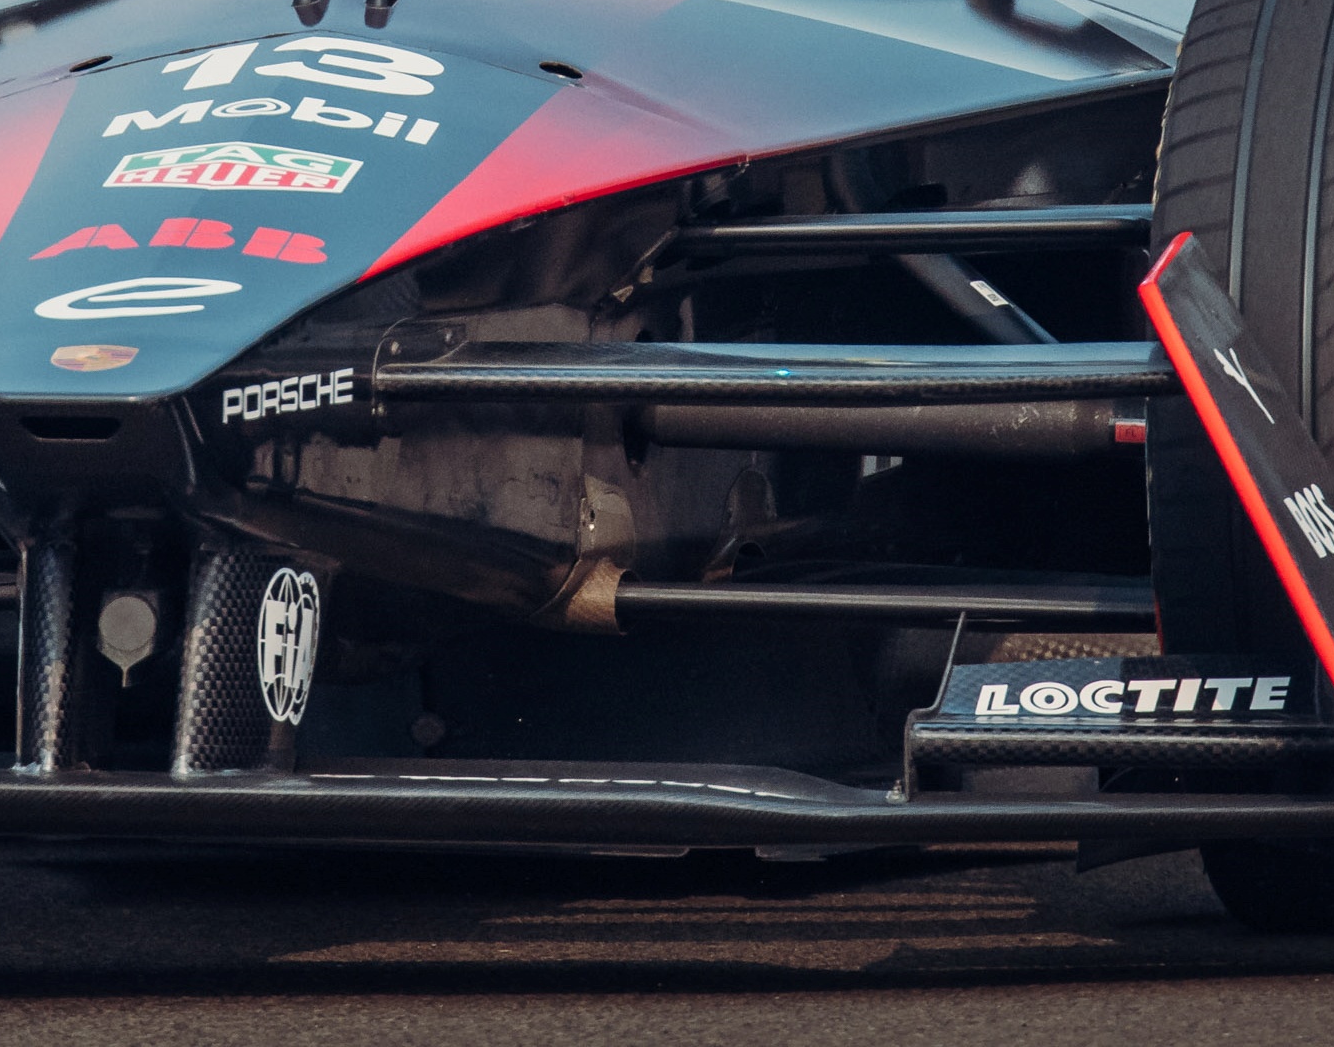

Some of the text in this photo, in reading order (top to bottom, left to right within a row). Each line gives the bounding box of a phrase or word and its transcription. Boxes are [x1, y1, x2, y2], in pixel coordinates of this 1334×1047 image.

[161, 36, 445, 96] 13
[102, 97, 440, 145] Mobil
[120, 161, 336, 189] HEUER
[141, 145, 336, 172] TAG
[29, 217, 328, 264] ABB
[222, 368, 355, 424] PORSCHE
[975, 676, 1292, 716] LOCTITE
